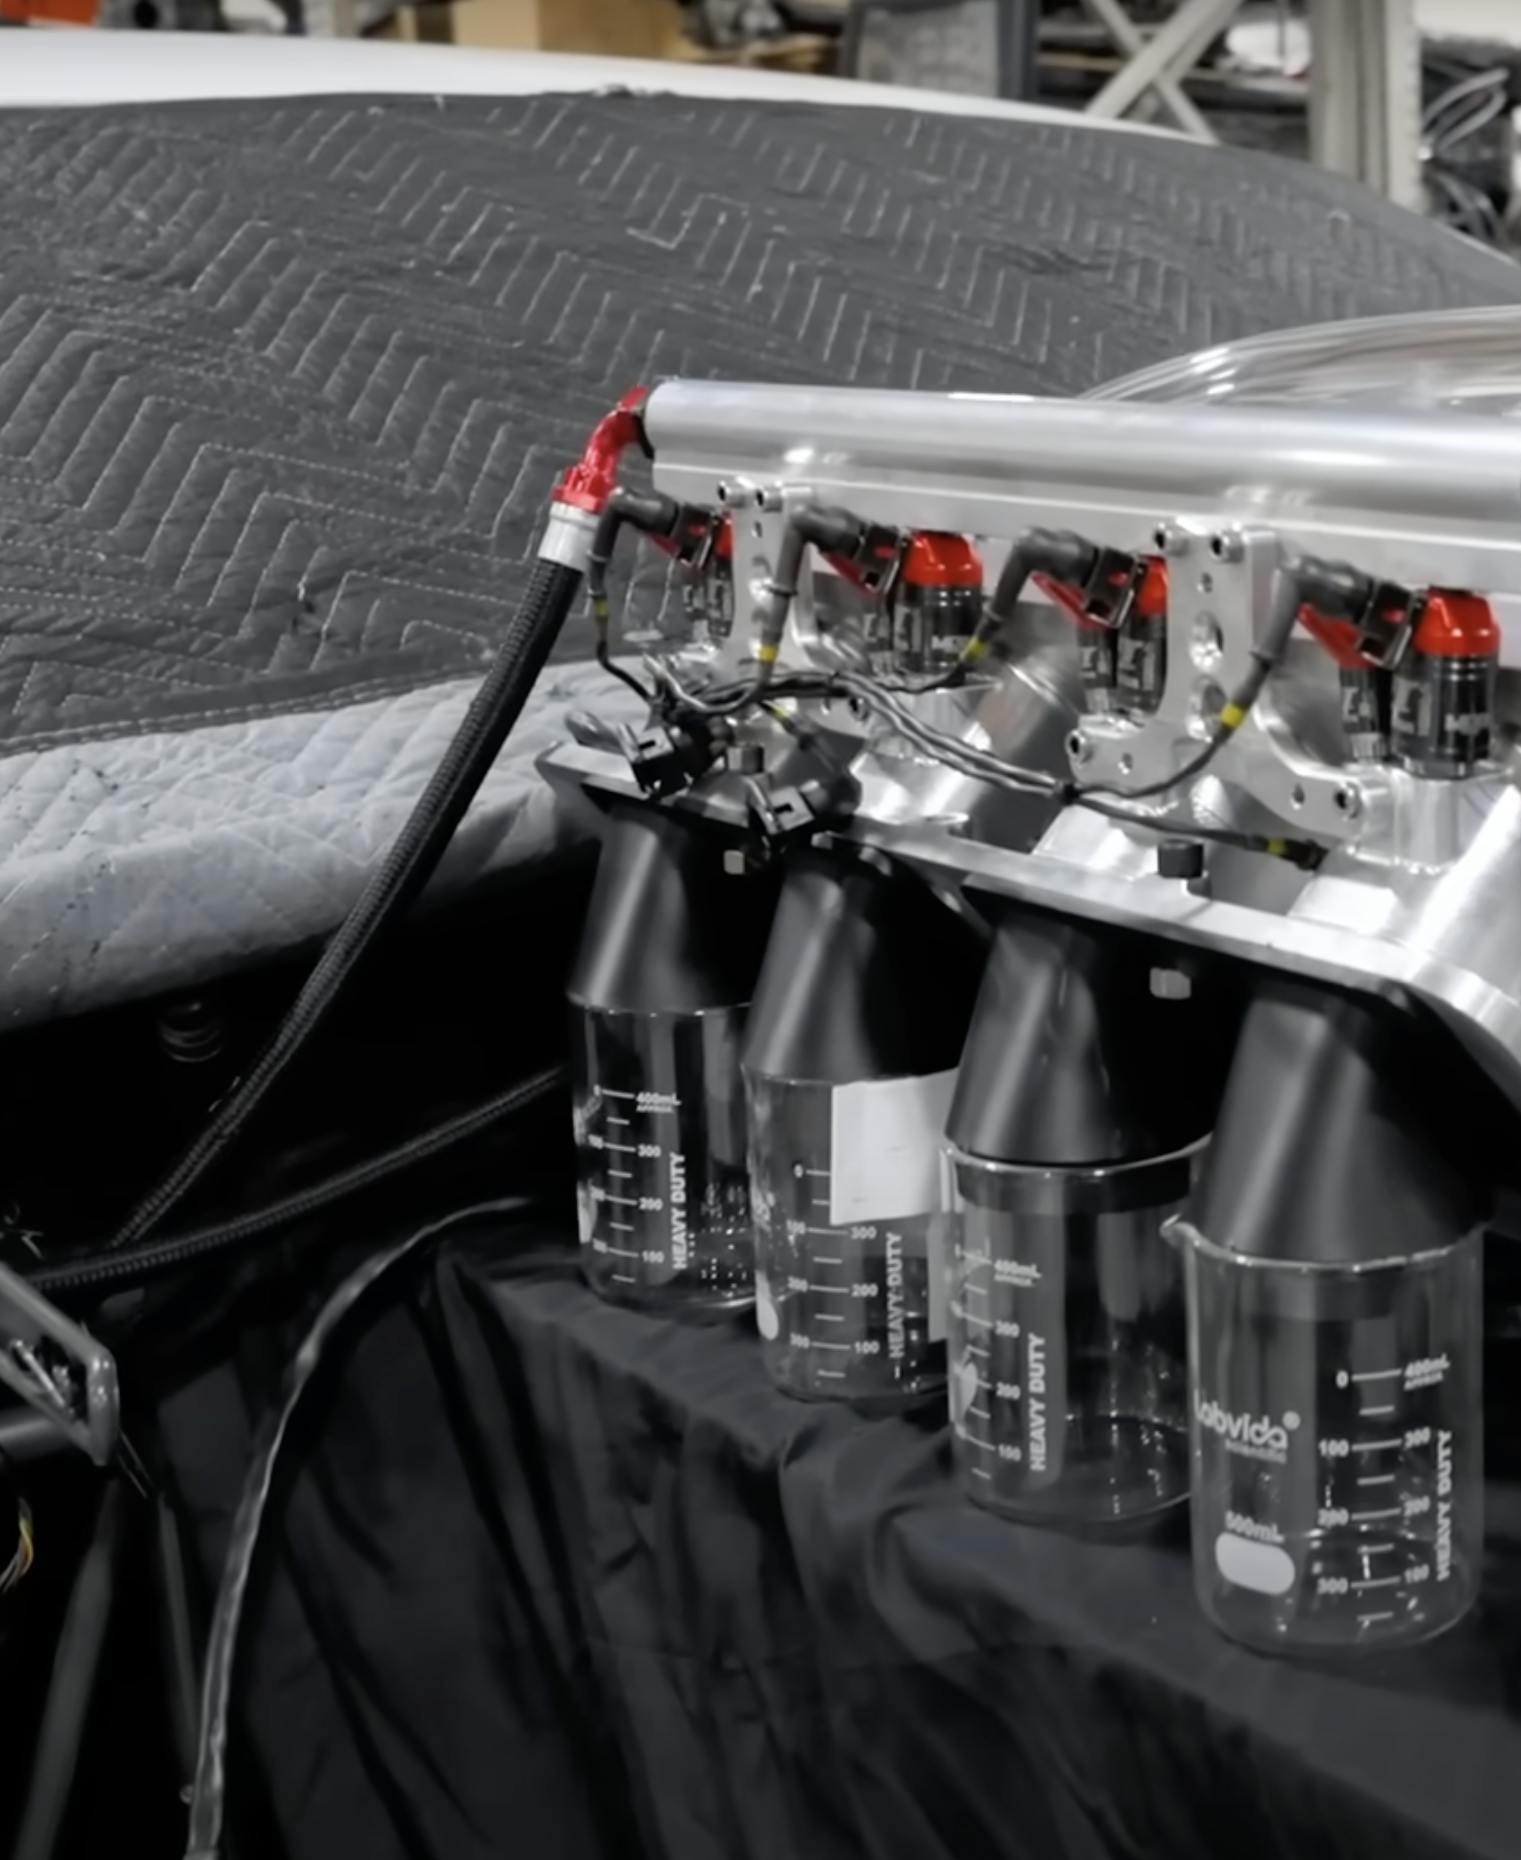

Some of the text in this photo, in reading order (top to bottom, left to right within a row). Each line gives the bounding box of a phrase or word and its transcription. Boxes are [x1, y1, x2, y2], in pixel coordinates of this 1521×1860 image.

[638, 1144, 662, 1158] 300
[639, 1197, 664, 1211] 200
[669, 1152, 688, 1270] HEAVY DUTY
[851, 1226, 877, 1240] 300
[642, 1250, 666, 1264] 100
[852, 1283, 879, 1297] 200
[886, 1232, 905, 1359] HEAVY DUTY
[854, 1340, 880, 1354] 100
[1336, 1370, 1349, 1389] 0
[1028, 1332, 1047, 1473] HEAVY DUTY
[1318, 1439, 1349, 1457] 100
[1436, 1430, 1452, 1581] HEAVY DUTY
[1405, 1564, 1430, 1585] 100
[1317, 1577, 1349, 1595] 300
